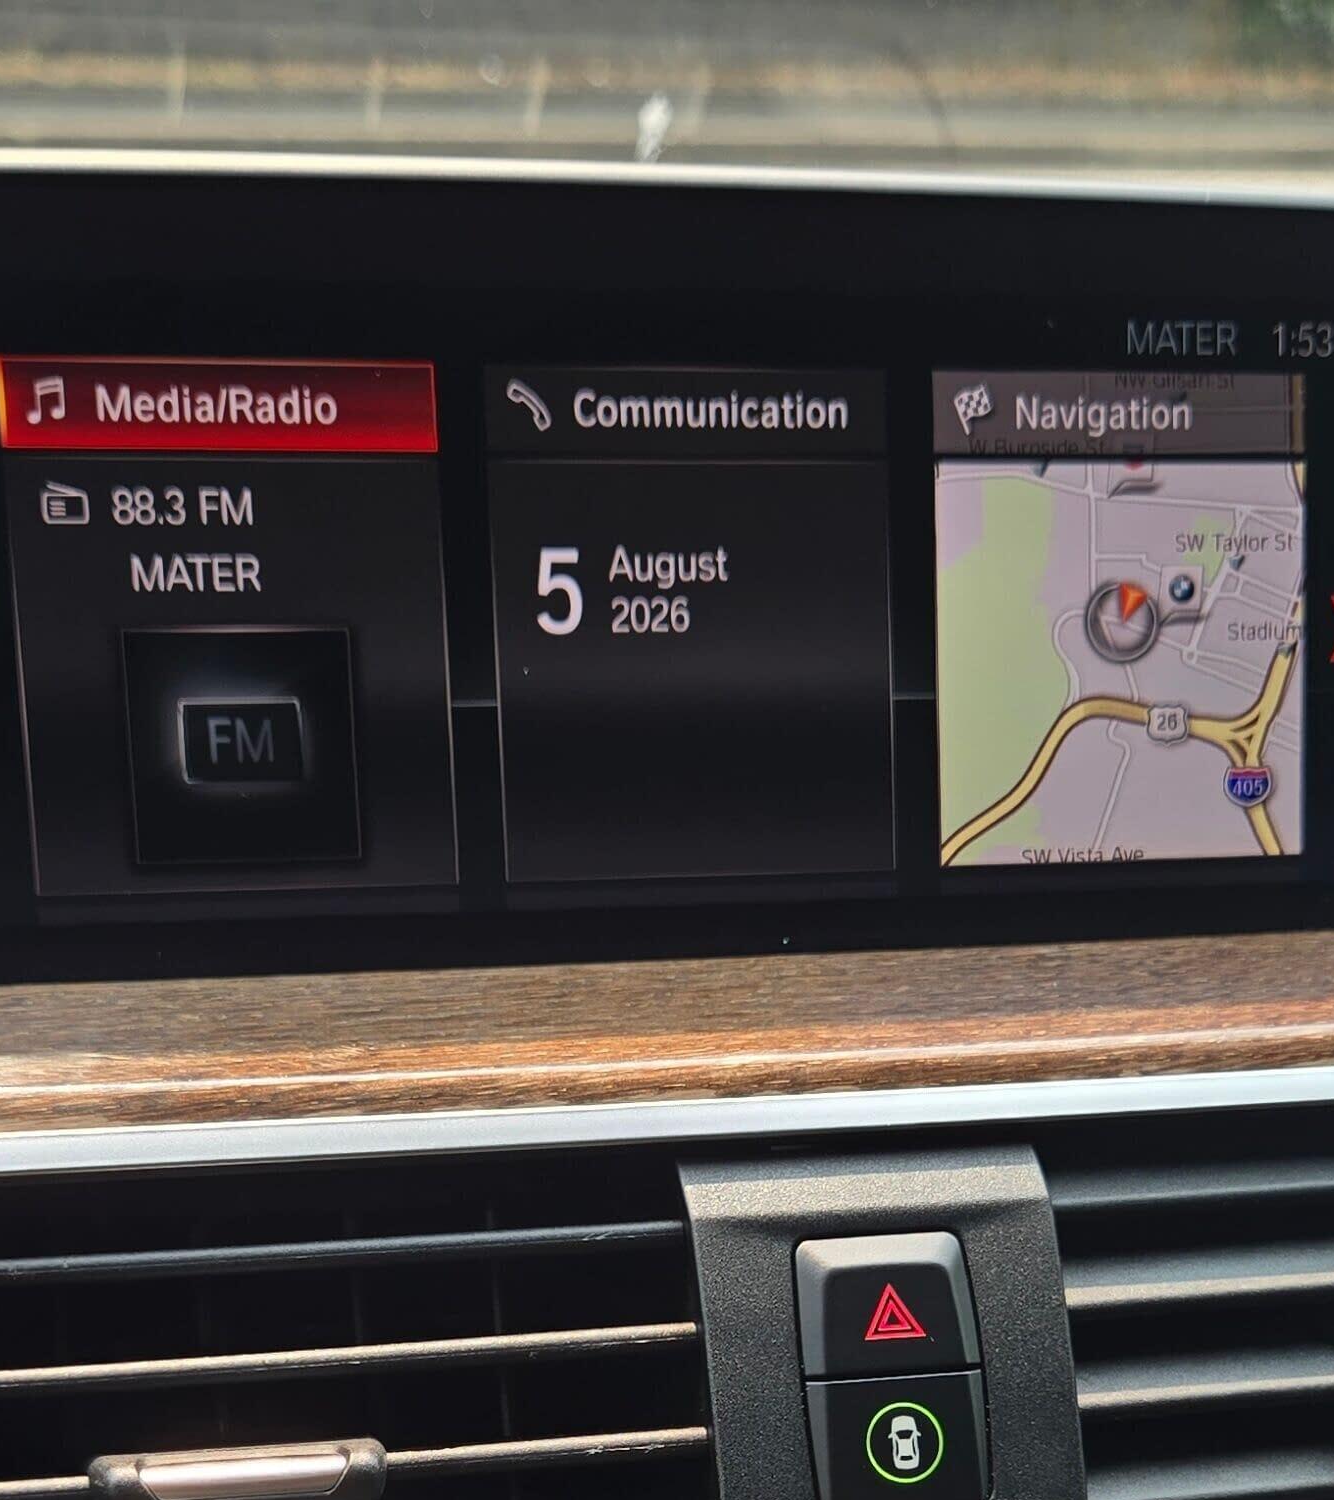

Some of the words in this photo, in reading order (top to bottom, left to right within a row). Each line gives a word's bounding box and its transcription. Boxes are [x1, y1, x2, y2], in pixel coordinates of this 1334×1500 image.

[1126, 318, 1237, 357] MATER
[1272, 322, 1334, 359] 1:53
[94, 383, 338, 426] Media/Radio
[572, 386, 850, 430] Communication
[1014, 394, 1194, 439] Navigation
[110, 487, 186, 526] 88.3
[198, 486, 255, 526] FM
[1175, 534, 1204, 553] SW
[1212, 533, 1269, 556] Taylor
[1274, 533, 1294, 552] St
[129, 552, 262, 593] MATER
[536, 545, 584, 636] 5
[608, 544, 730, 590] August
[610, 594, 691, 634] 2026
[209, 717, 275, 765] FM
[1157, 713, 1178, 731] 26
[1232, 778, 1264, 797] 405
